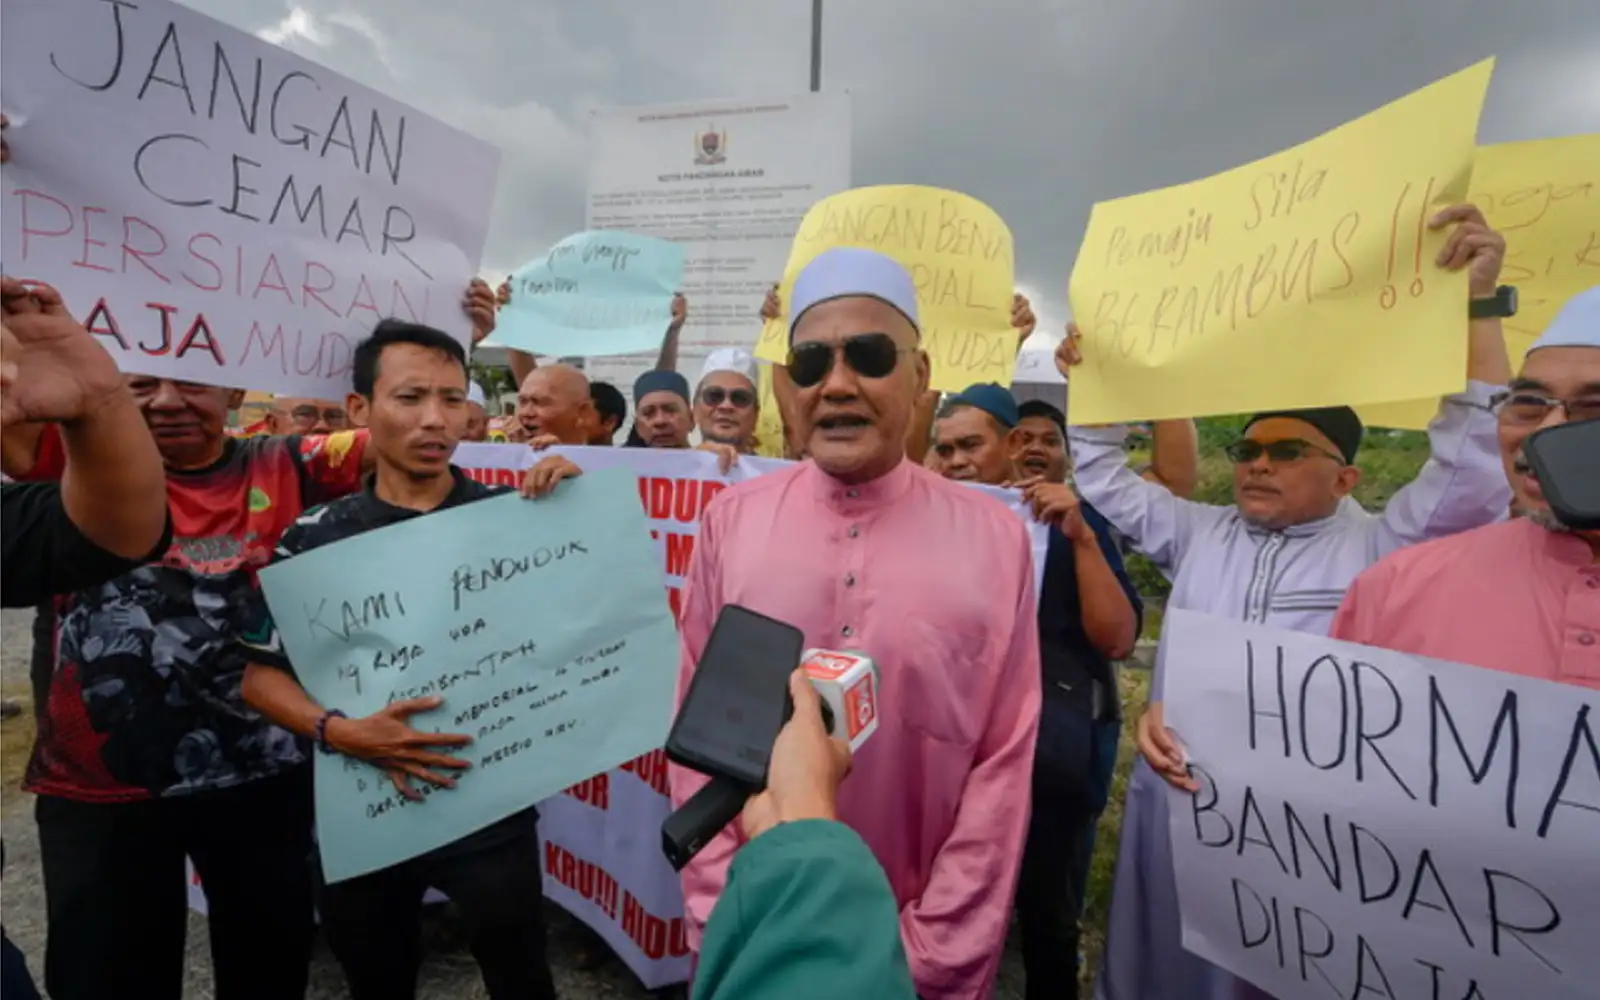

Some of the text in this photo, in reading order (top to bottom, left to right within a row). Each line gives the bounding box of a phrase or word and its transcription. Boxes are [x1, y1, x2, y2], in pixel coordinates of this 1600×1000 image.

[49, 0, 406, 186] JANGAN
[12, 188, 431, 336] PERSIARAN
[134, 133, 434, 281] CEMAR
[238, 319, 354, 382] MUD
[303, 591, 406, 642] KAMI
[1185, 762, 1563, 975] BANDAR
